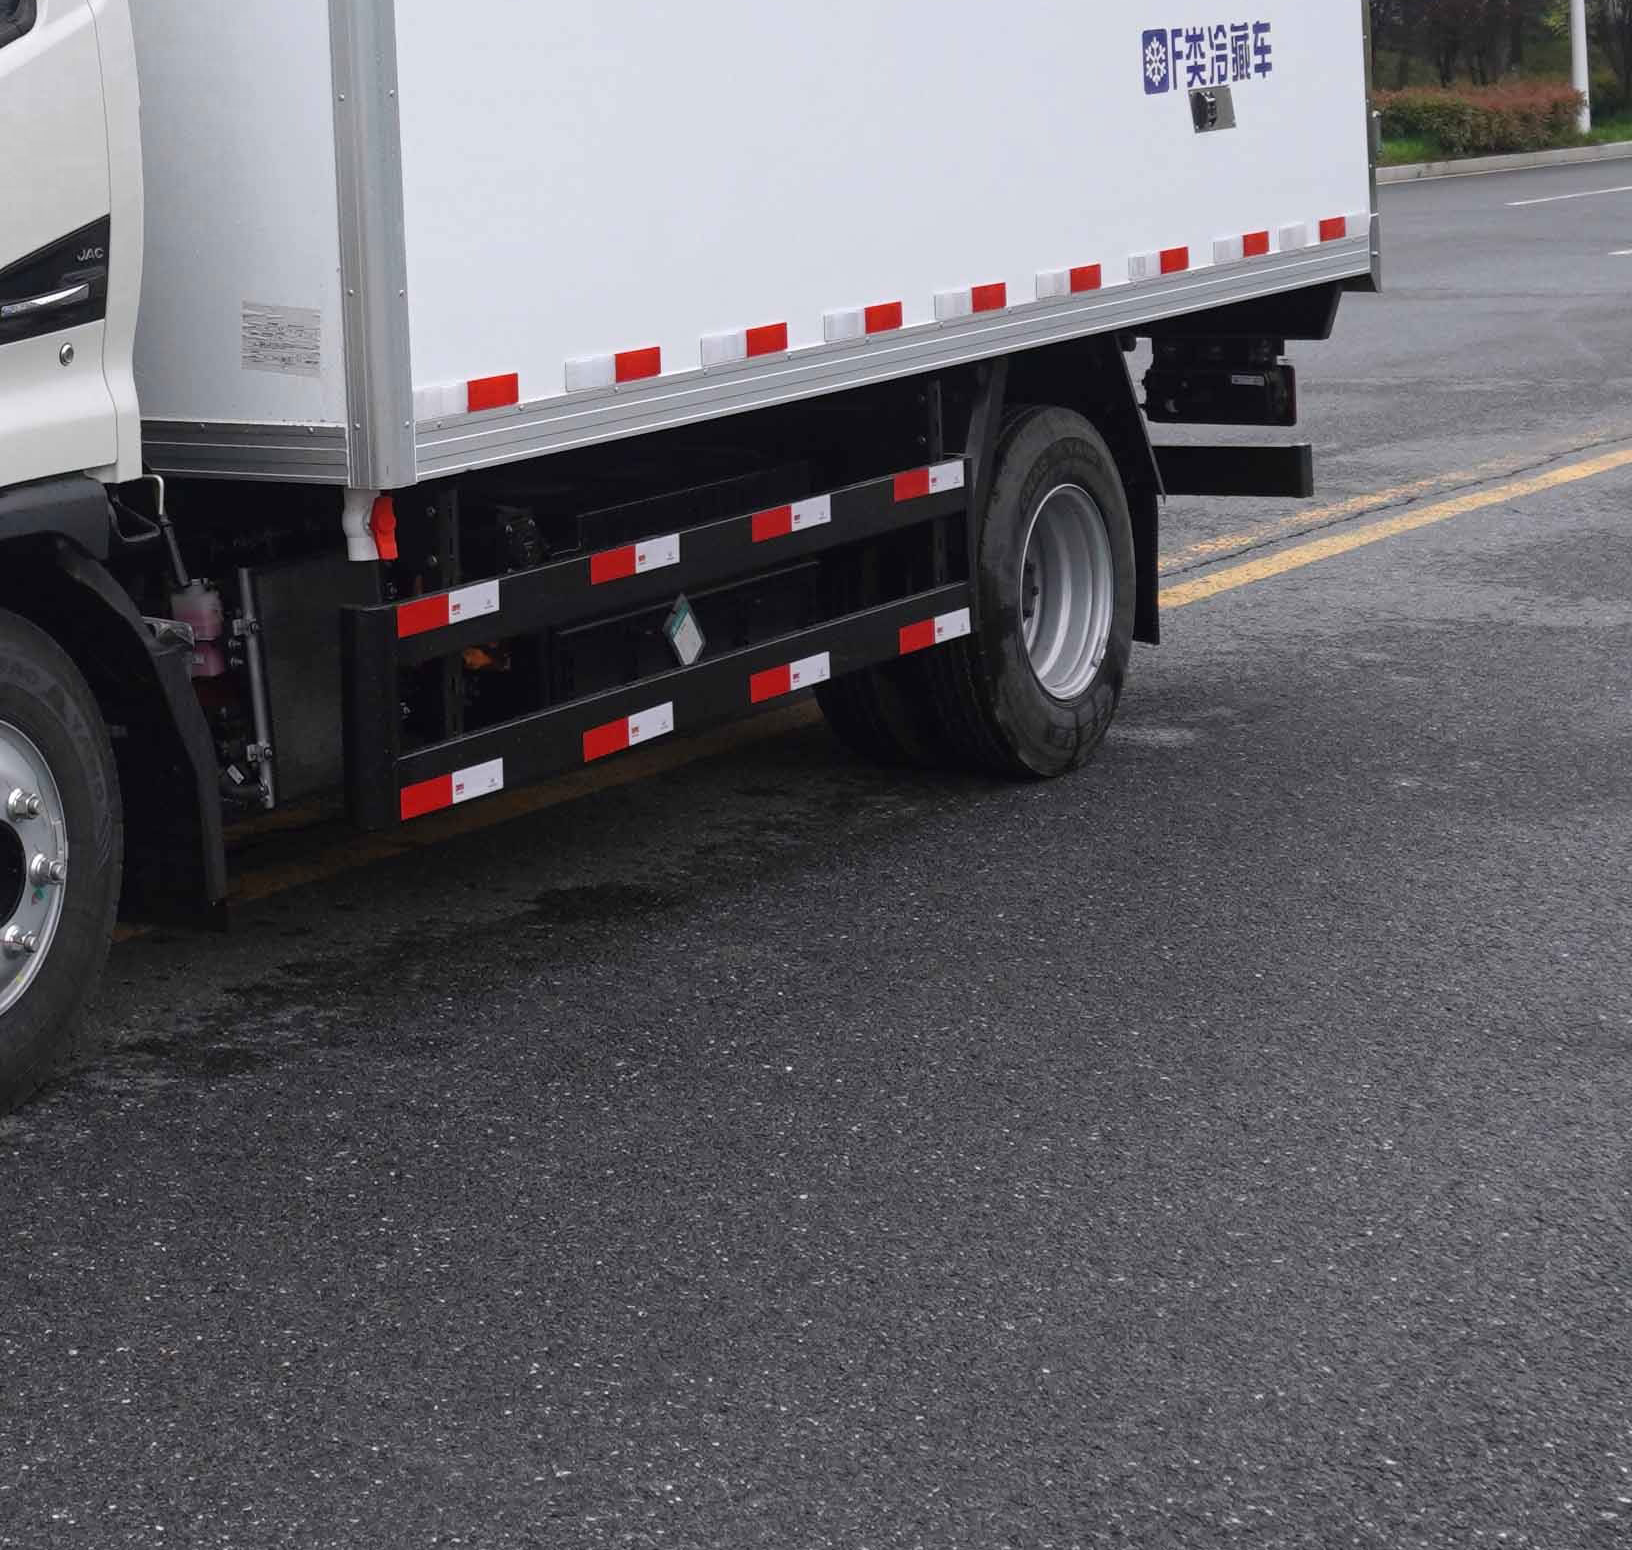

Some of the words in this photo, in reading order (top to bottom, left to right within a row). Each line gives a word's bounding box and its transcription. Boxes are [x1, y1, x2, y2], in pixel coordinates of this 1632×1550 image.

[1171, 20, 1273, 91] F类冷藏车
[77, 247, 104, 261] JAC
